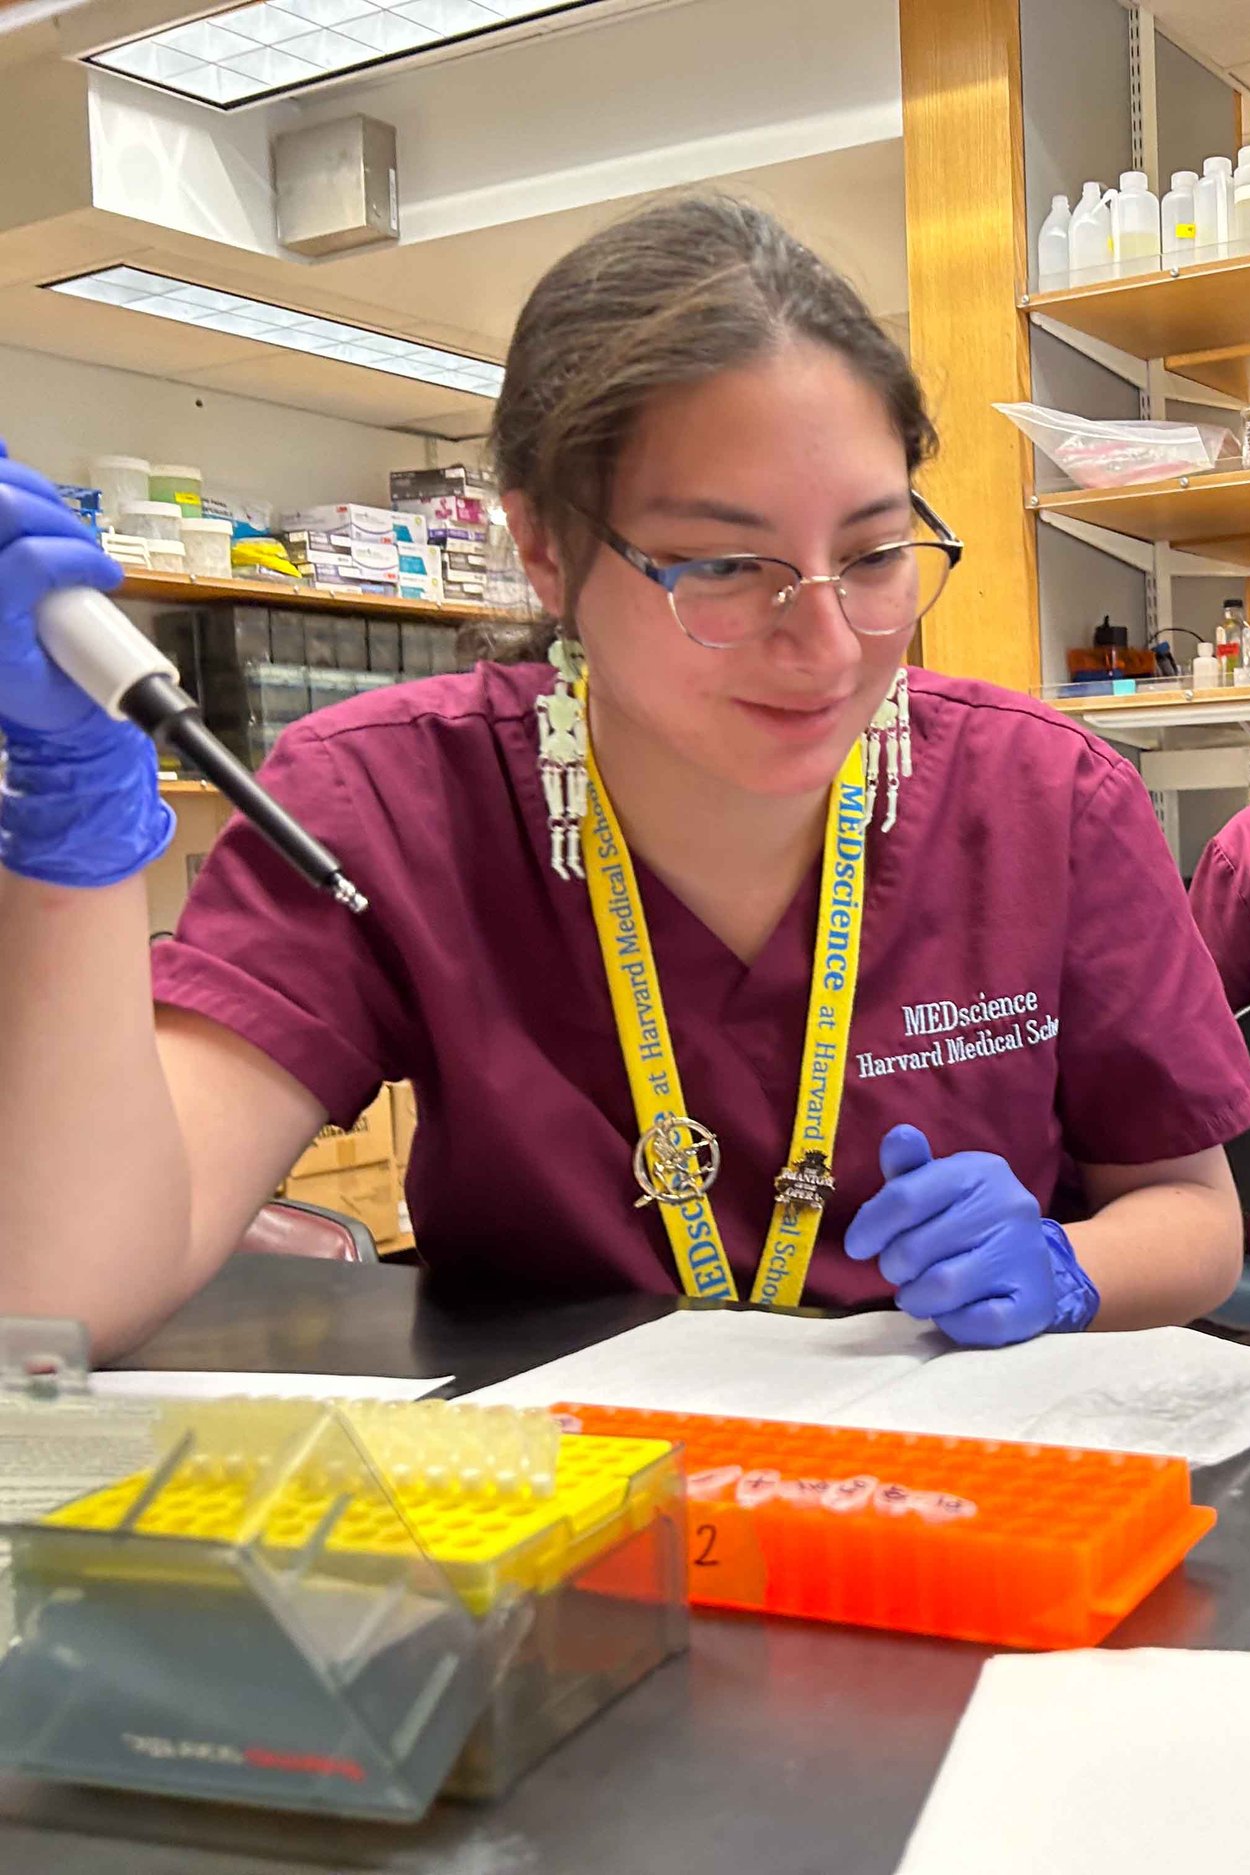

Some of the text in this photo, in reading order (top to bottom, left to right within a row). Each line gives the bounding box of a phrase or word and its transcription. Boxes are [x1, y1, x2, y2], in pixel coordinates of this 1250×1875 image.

[601, 863, 641, 957] Medical
[803, 783, 865, 1141] MEDscience at Harvard
[620, 961, 664, 1062] Harvard
[901, 991, 1038, 1037] MEDscience
[856, 1041, 944, 1079] Harvard
[946, 1023, 1024, 1064] Medical
[648, 1070, 671, 1096] at
[694, 1524, 720, 1566] 2
